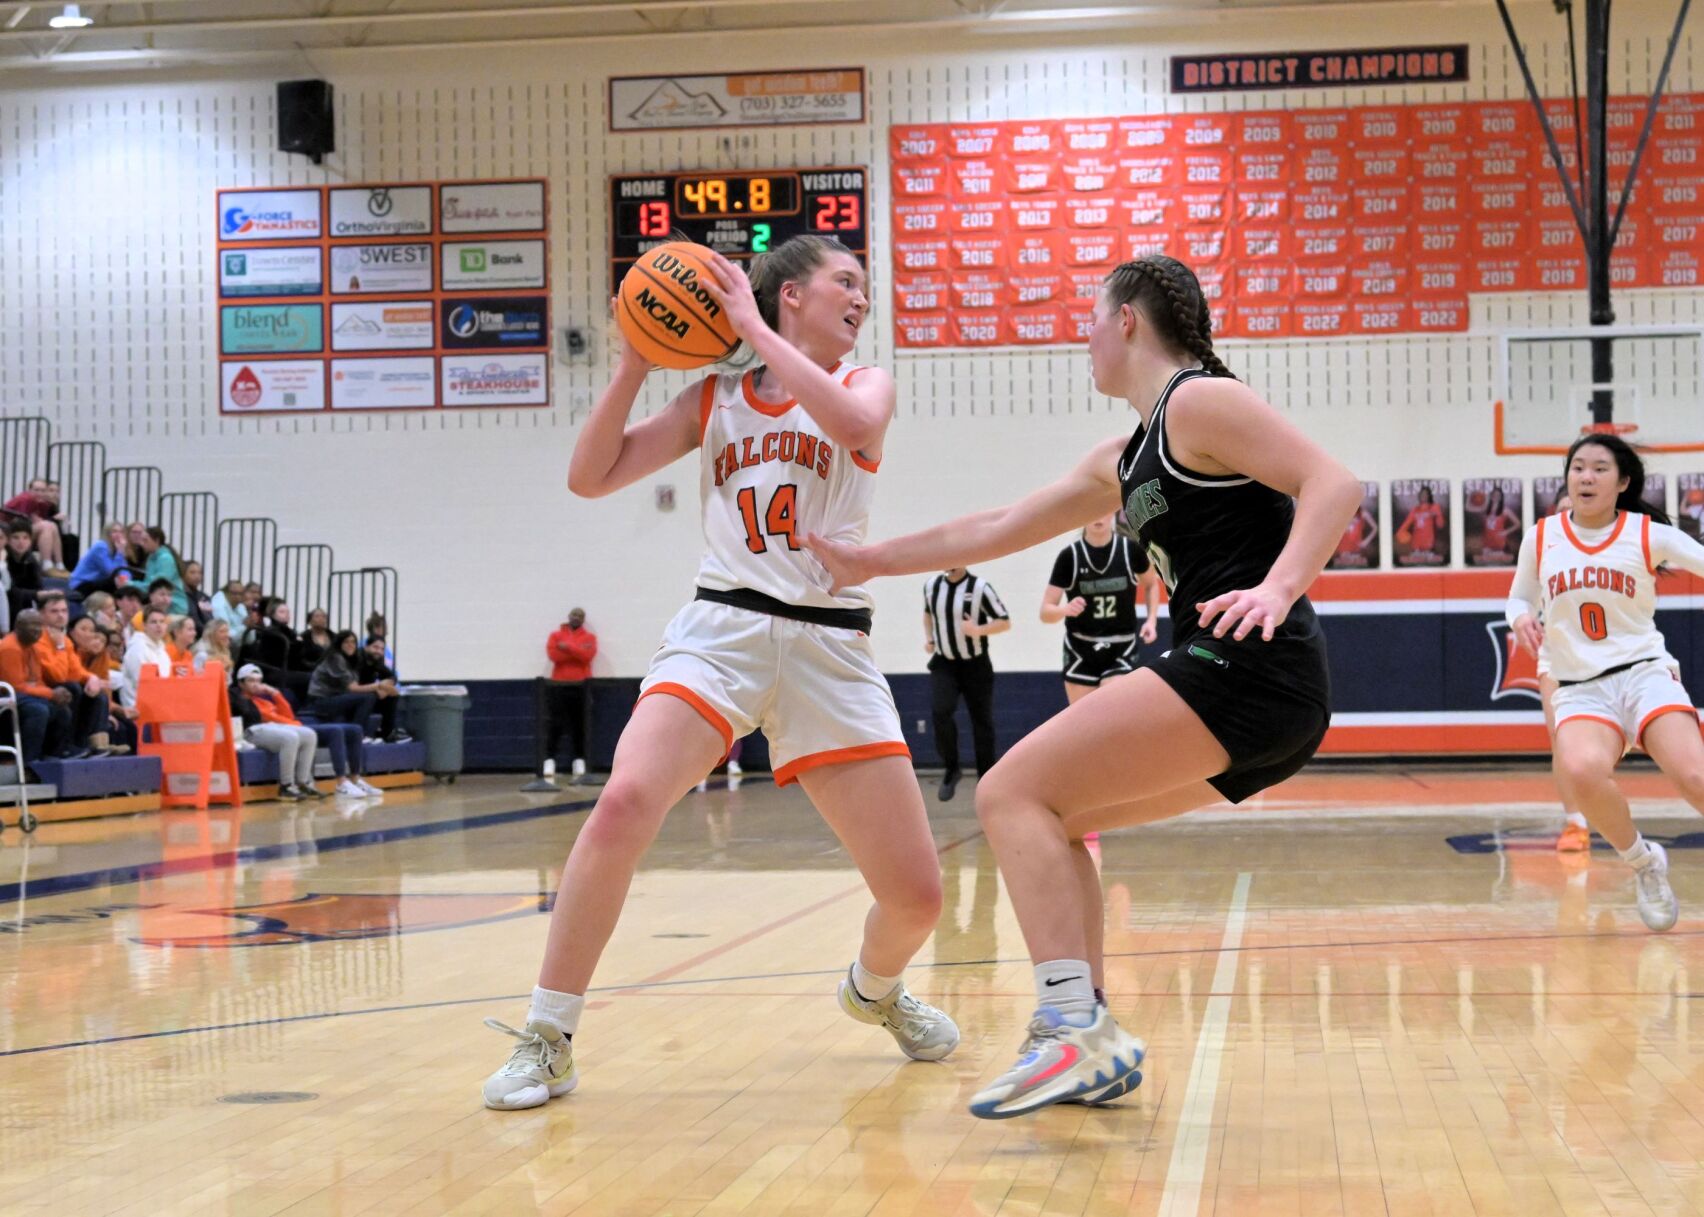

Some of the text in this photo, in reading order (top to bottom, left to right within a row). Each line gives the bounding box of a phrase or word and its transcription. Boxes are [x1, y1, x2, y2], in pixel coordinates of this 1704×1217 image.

[1184, 52, 1455, 86] DISTRICT CHAMPIONS
[1422, 120, 1456, 135] 2010
[1482, 117, 1515, 133] 2010
[1664, 114, 1694, 129] 2011
[1185, 128, 1222, 144] 2009
[1243, 126, 1280, 142] 2009
[1305, 125, 1338, 139] 2010
[1363, 122, 1396, 137] 2010
[901, 140, 936, 154] 2007
[956, 138, 993, 152] 2007
[1187, 167, 1220, 182] 2012
[1246, 165, 1279, 180] 2012
[1305, 167, 1338, 182] 2012
[1364, 161, 1396, 175] 2012
[1483, 160, 1515, 175] 2012
[621, 181, 666, 197] HOME
[802, 173, 863, 190] VISITOR
[905, 178, 934, 193] 2011
[962, 178, 991, 193] 2011
[685, 178, 770, 213] 49.8
[1482, 194, 1515, 209] 2015
[1663, 188, 1696, 203] 2015
[1188, 203, 1221, 219] 2014
[1246, 201, 1279, 217] 2014
[1363, 198, 1397, 214] 2014
[1423, 196, 1456, 211] 2014
[640, 202, 670, 236] 13
[816, 195, 859, 230] 23
[1017, 210, 1051, 226] 2013
[1304, 204, 1338, 220] 2014
[336, 221, 426, 234] OrthoVirginia
[904, 214, 936, 230] 2013
[961, 212, 994, 228] 2013
[706, 230, 748, 243] PERIOD
[752, 223, 771, 252] 2
[1422, 235, 1456, 249] 2017
[1482, 232, 1515, 247] 2017
[1542, 231, 1574, 246] 2017
[1662, 227, 1696, 242] 2017
[1190, 241, 1221, 257] 2016
[1246, 240, 1279, 255] 2016
[1304, 239, 1337, 254] 2016
[1363, 237, 1396, 251] 2017
[491, 253, 523, 264] Bank
[905, 252, 936, 267] 2016
[961, 250, 993, 265] 2016
[1018, 248, 1050, 264] 2016
[1076, 245, 1108, 261] 2016
[1481, 271, 1515, 285] 2019
[1542, 270, 1574, 285] 2019
[1663, 269, 1696, 284] 2019
[652, 253, 720, 319] Wilson
[1305, 277, 1337, 292] 2018
[1362, 279, 1396, 294] 2019
[905, 294, 937, 308] 2018
[962, 292, 994, 307] 2018
[1019, 287, 1051, 302] 2018
[635, 287, 690, 339] NCAA
[1362, 313, 1398, 328] 2022
[1420, 311, 1457, 326] 2022
[234, 307, 289, 336] blend
[1248, 317, 1280, 331] 2021
[1303, 315, 1340, 329] 2022
[907, 327, 938, 341] 2019
[961, 327, 996, 340] 2020
[1017, 325, 1053, 339] 2020
[450, 380, 540, 391] STEAKHOUSE
[714, 431, 833, 487] FALCONS
[737, 484, 801, 555] 14
[1548, 566, 1636, 600] FALCONS
[1093, 596, 1116, 618] 32
[1579, 602, 1607, 641] 0
